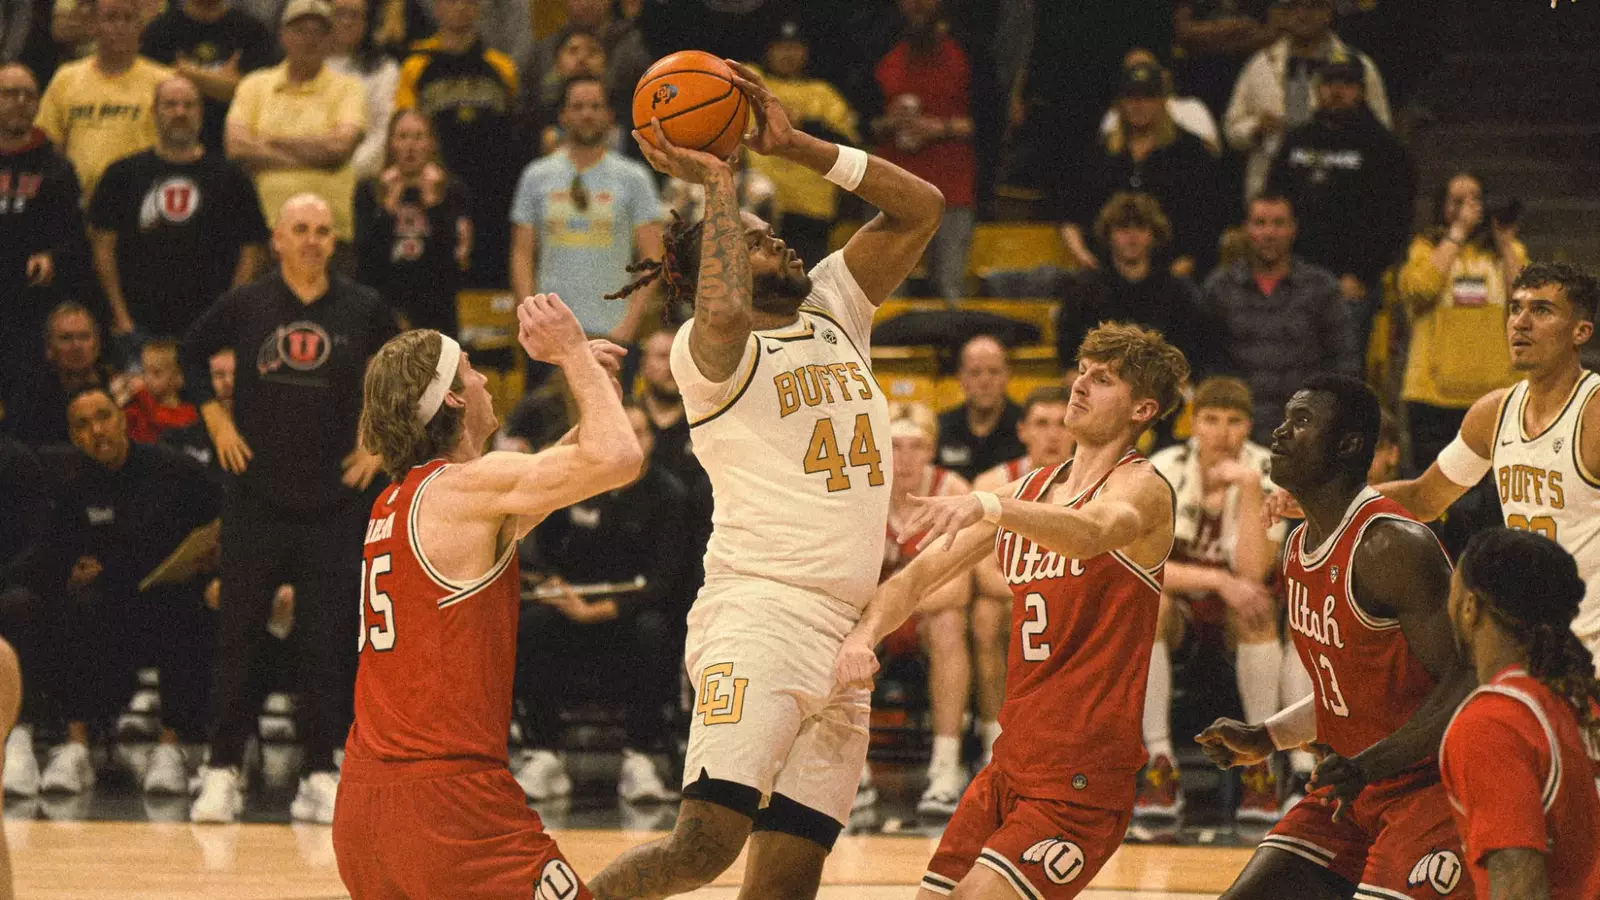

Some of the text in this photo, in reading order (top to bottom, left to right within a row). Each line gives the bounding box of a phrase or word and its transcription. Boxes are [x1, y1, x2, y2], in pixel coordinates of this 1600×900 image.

[164, 187, 190, 217] U
[288, 329, 320, 363] U
[773, 361, 873, 418] BUFFS
[803, 413, 885, 492] 44
[1498, 464, 1565, 510] BUFFS
[1021, 592, 1051, 661] 2
[1287, 577, 1345, 649] Utah
[697, 661, 749, 726] CU
[1308, 648, 1349, 717] 13
[544, 863, 575, 900] U
[1048, 844, 1082, 880] U
[1434, 854, 1460, 889] U
